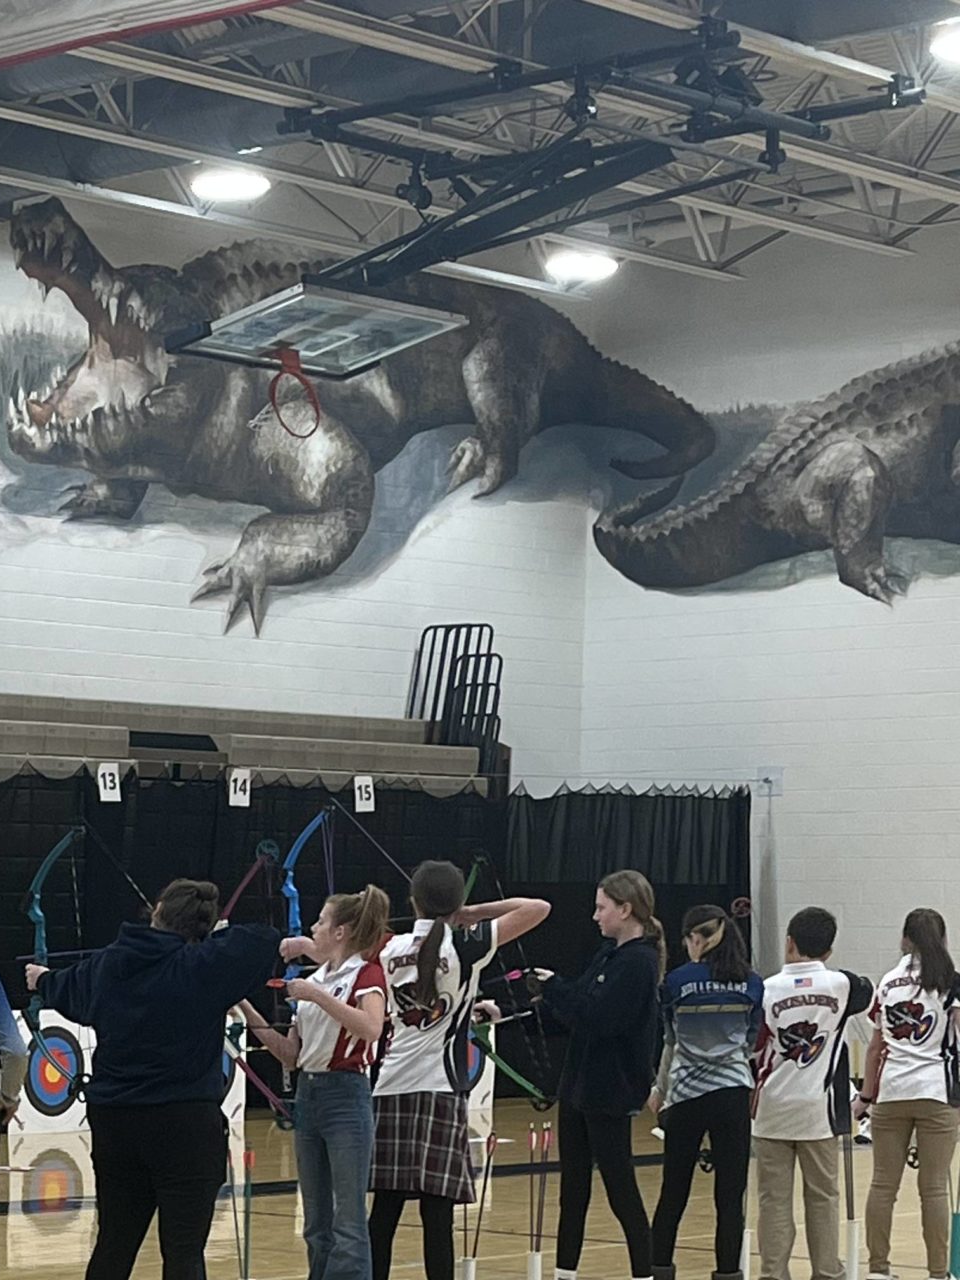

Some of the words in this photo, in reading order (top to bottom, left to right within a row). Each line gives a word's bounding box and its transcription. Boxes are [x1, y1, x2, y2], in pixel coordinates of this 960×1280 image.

[100, 772, 116, 790] 13
[232, 777, 247, 795] 14
[357, 784, 372, 801] 15
[772, 994, 839, 1018] CRUSADERS
